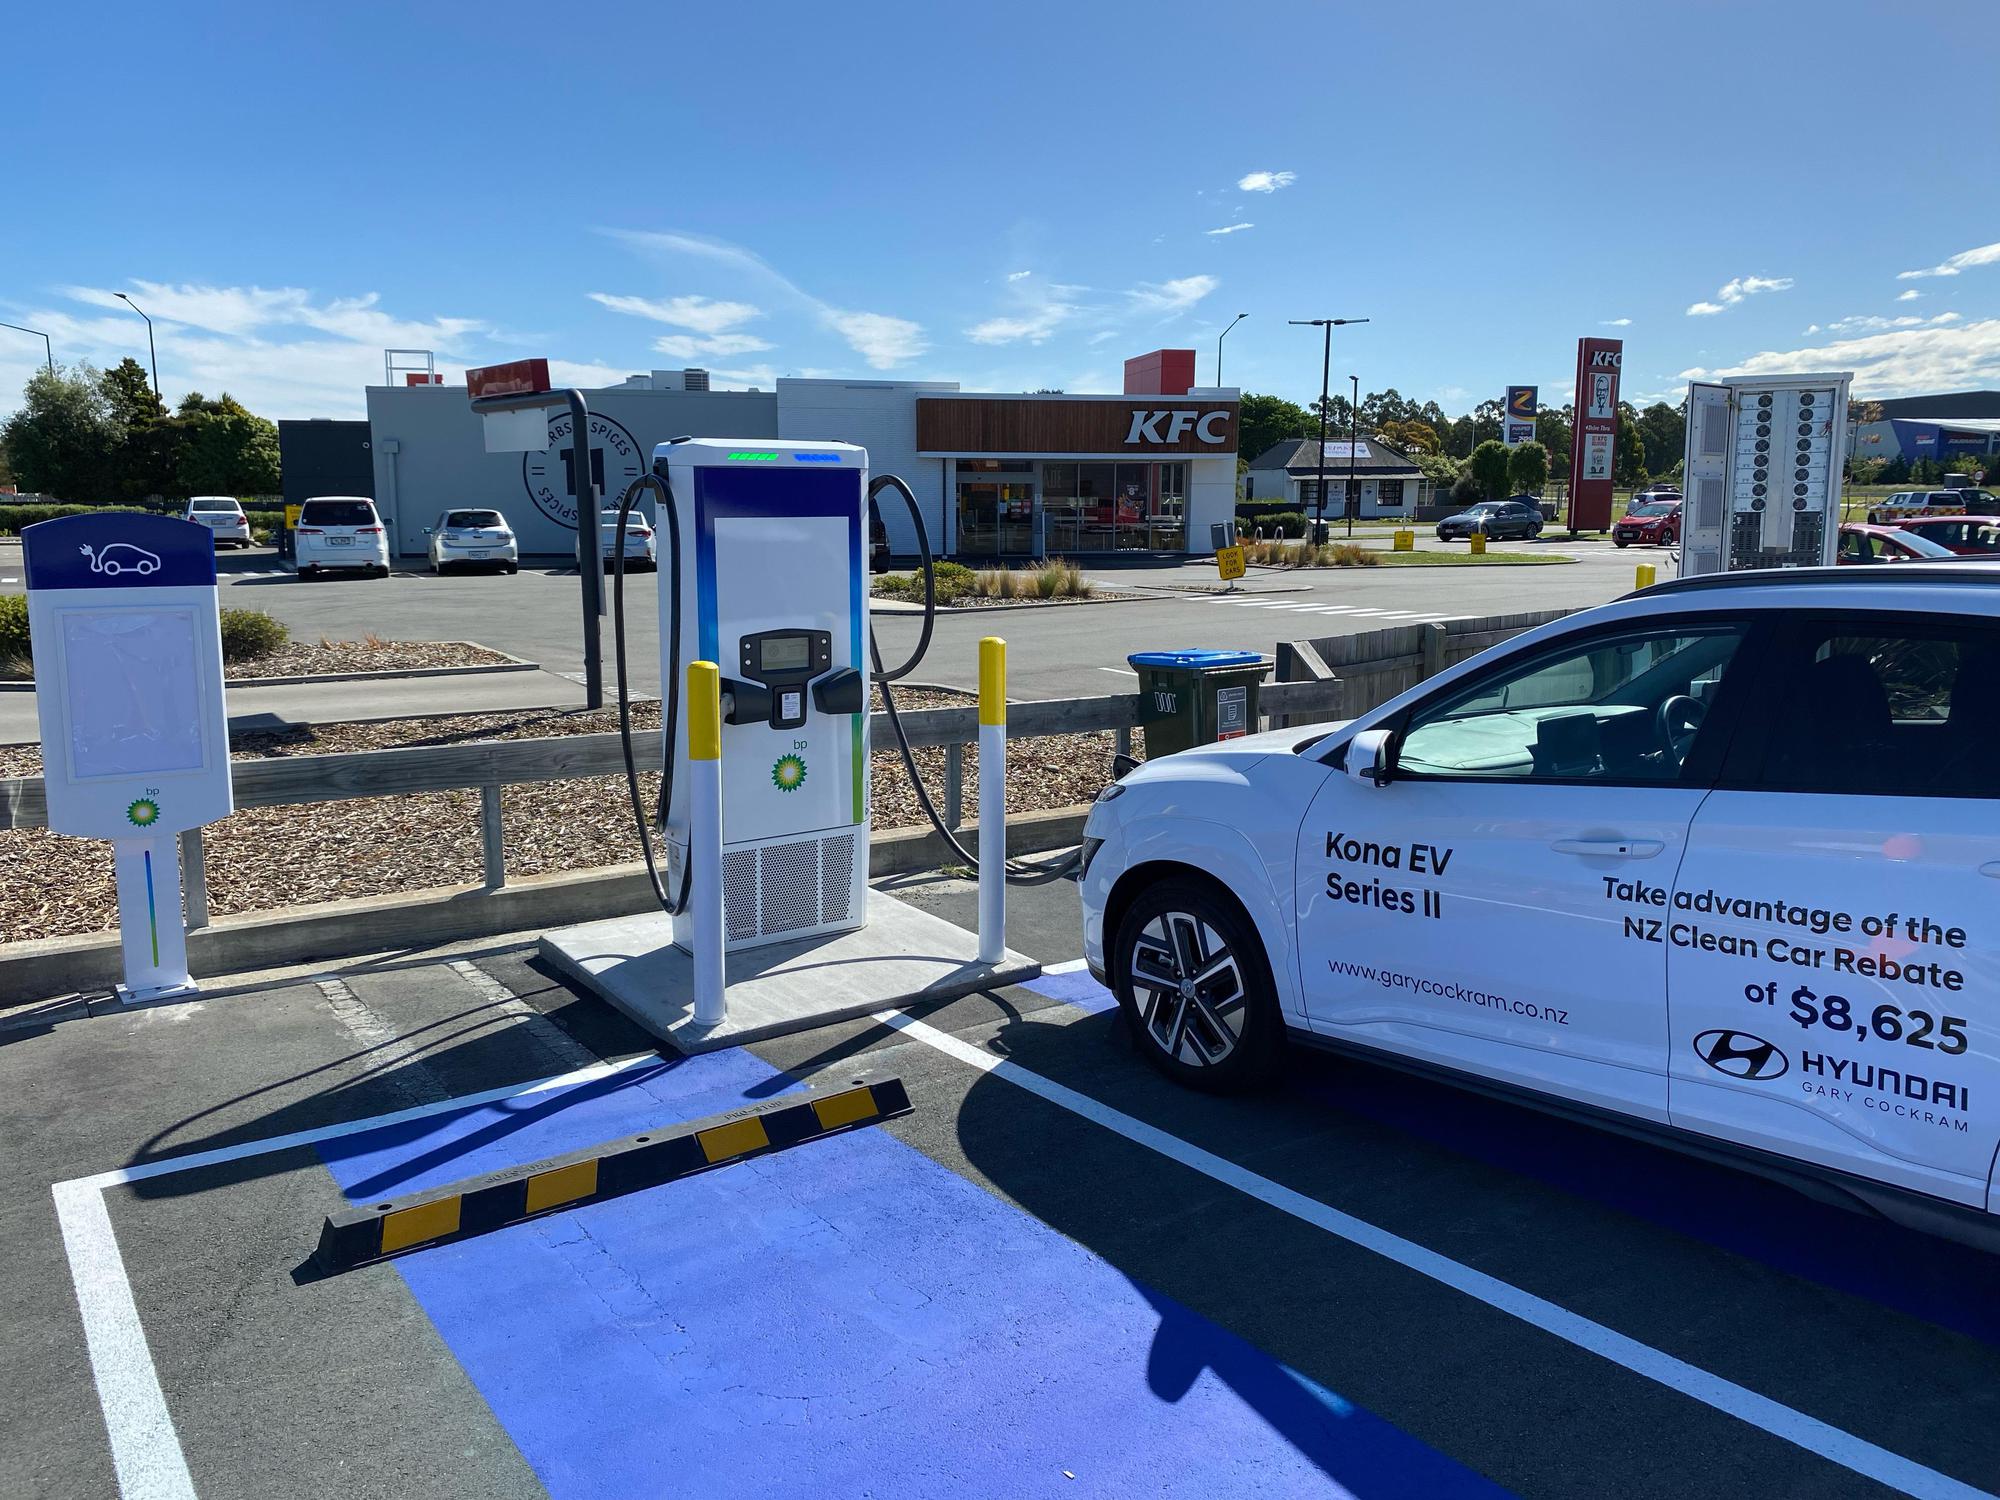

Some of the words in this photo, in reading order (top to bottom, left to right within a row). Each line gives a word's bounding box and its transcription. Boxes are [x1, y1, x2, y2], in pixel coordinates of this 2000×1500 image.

[1592, 351, 1622, 367] KFC
[539, 422, 573, 455] RBS
[590, 421, 631, 456] SPICES
[1124, 410, 1231, 444] KFC
[538, 486, 578, 521] SPICES
[1222, 551, 1239, 560] LOOK
[1225, 567, 1241, 575] CARS
[793, 739, 808, 752] bp
[145, 787, 160, 797] bp
[1325, 831, 1401, 869] Kona
[1408, 843, 1453, 876] EV
[1325, 872, 1416, 914] Series
[1423, 888, 1441, 919] II
[1602, 876, 1667, 907] Take
[1674, 889, 1852, 934] advantage
[1860, 912, 1898, 939] of
[1905, 916, 1967, 949] the
[1623, 916, 1663, 943] NZ
[1669, 923, 1758, 958] Clean
[1766, 938, 1826, 968] Car
[1834, 947, 1964, 991] Rebate
[1328, 959, 1569, 1025] www.garycockram.co.nz
[1744, 981, 1778, 1006] of
[1789, 985, 1969, 1055] $8,625
[1802, 1050, 1969, 1112] HYUNDAI
[1802, 1081, 1853, 1103] GARY
[1864, 1097, 1969, 1133] COCKRAM
